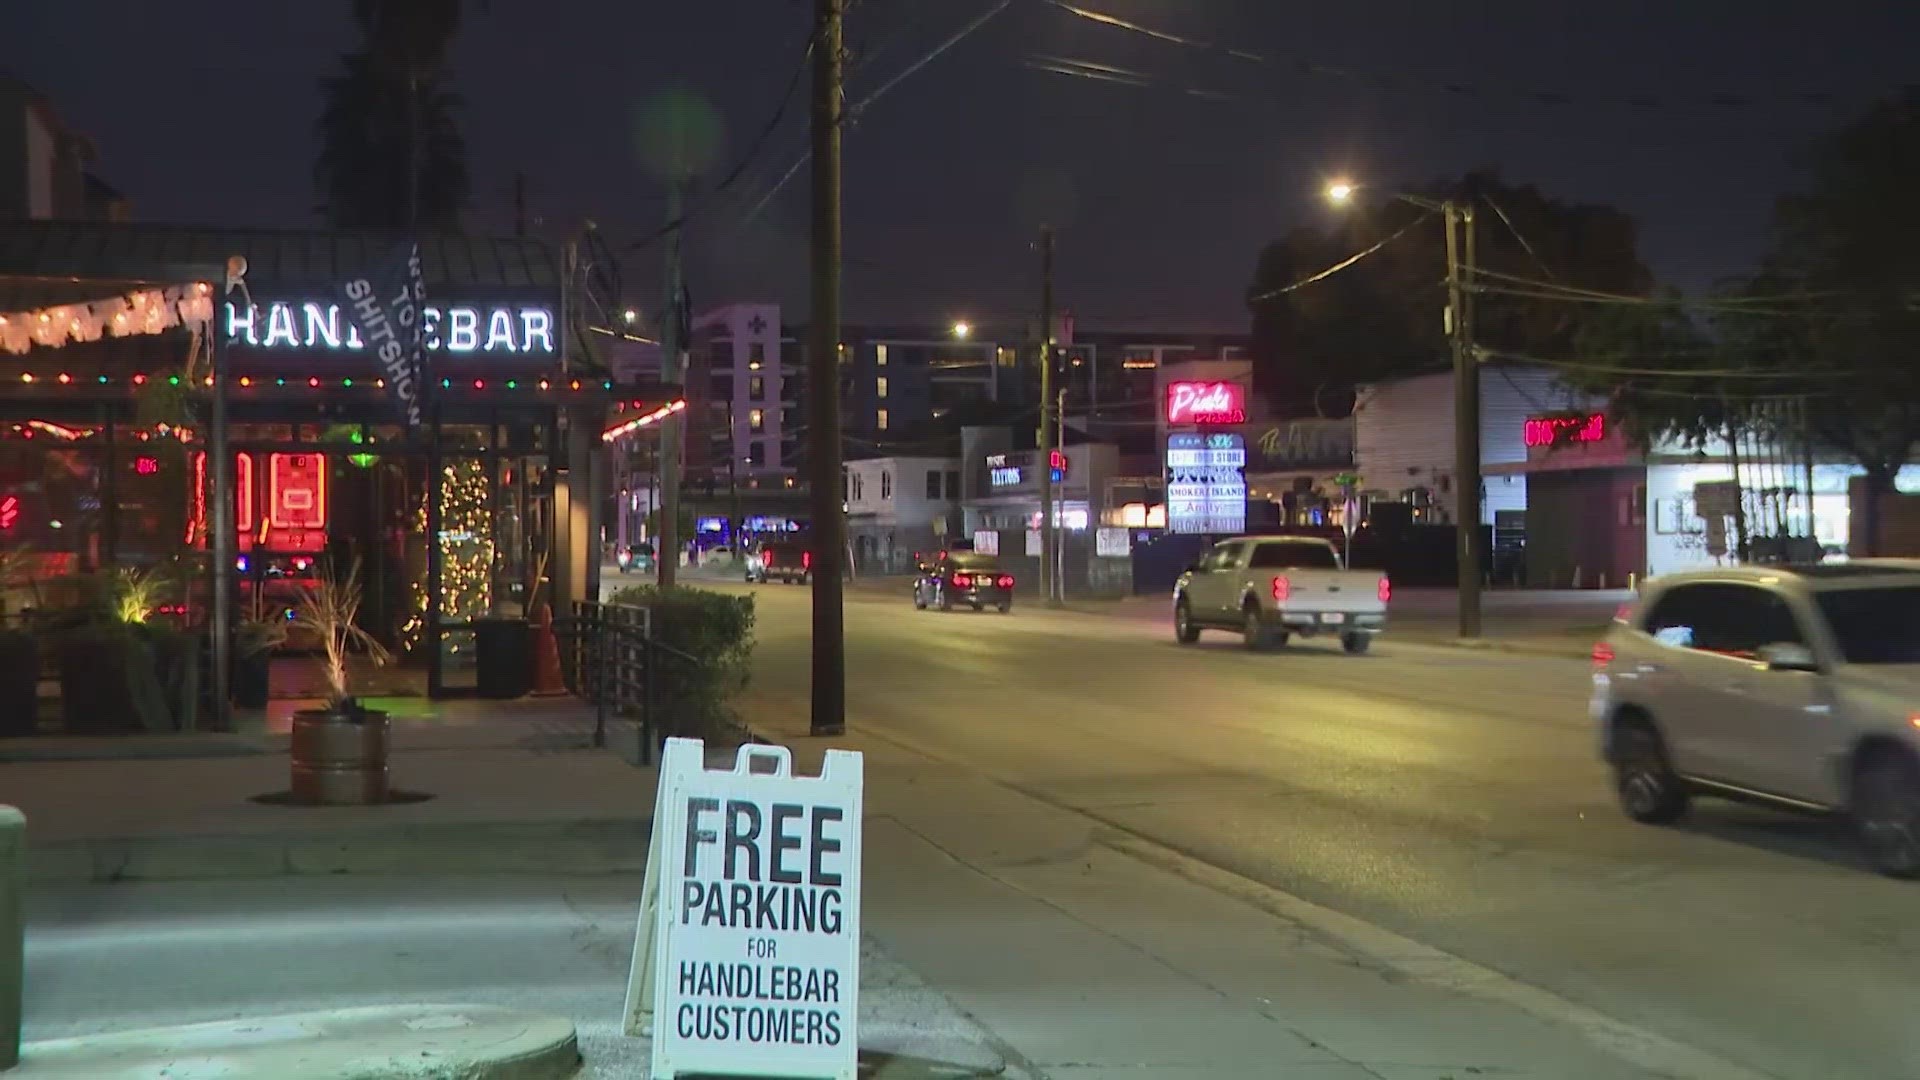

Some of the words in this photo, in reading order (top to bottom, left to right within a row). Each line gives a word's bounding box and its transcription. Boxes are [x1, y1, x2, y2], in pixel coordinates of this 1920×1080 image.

[224, 301, 554, 352] HANEBAR
[345, 278, 421, 426] SHITSHOW
[1211, 486, 1245, 498] ISLAND
[684, 797, 843, 886] FREE
[681, 880, 842, 934] PARKING
[747, 938, 777, 958] FOR
[679, 960, 839, 1002] HANDLEBAR
[677, 1003, 841, 1046] CUSTOMERS
